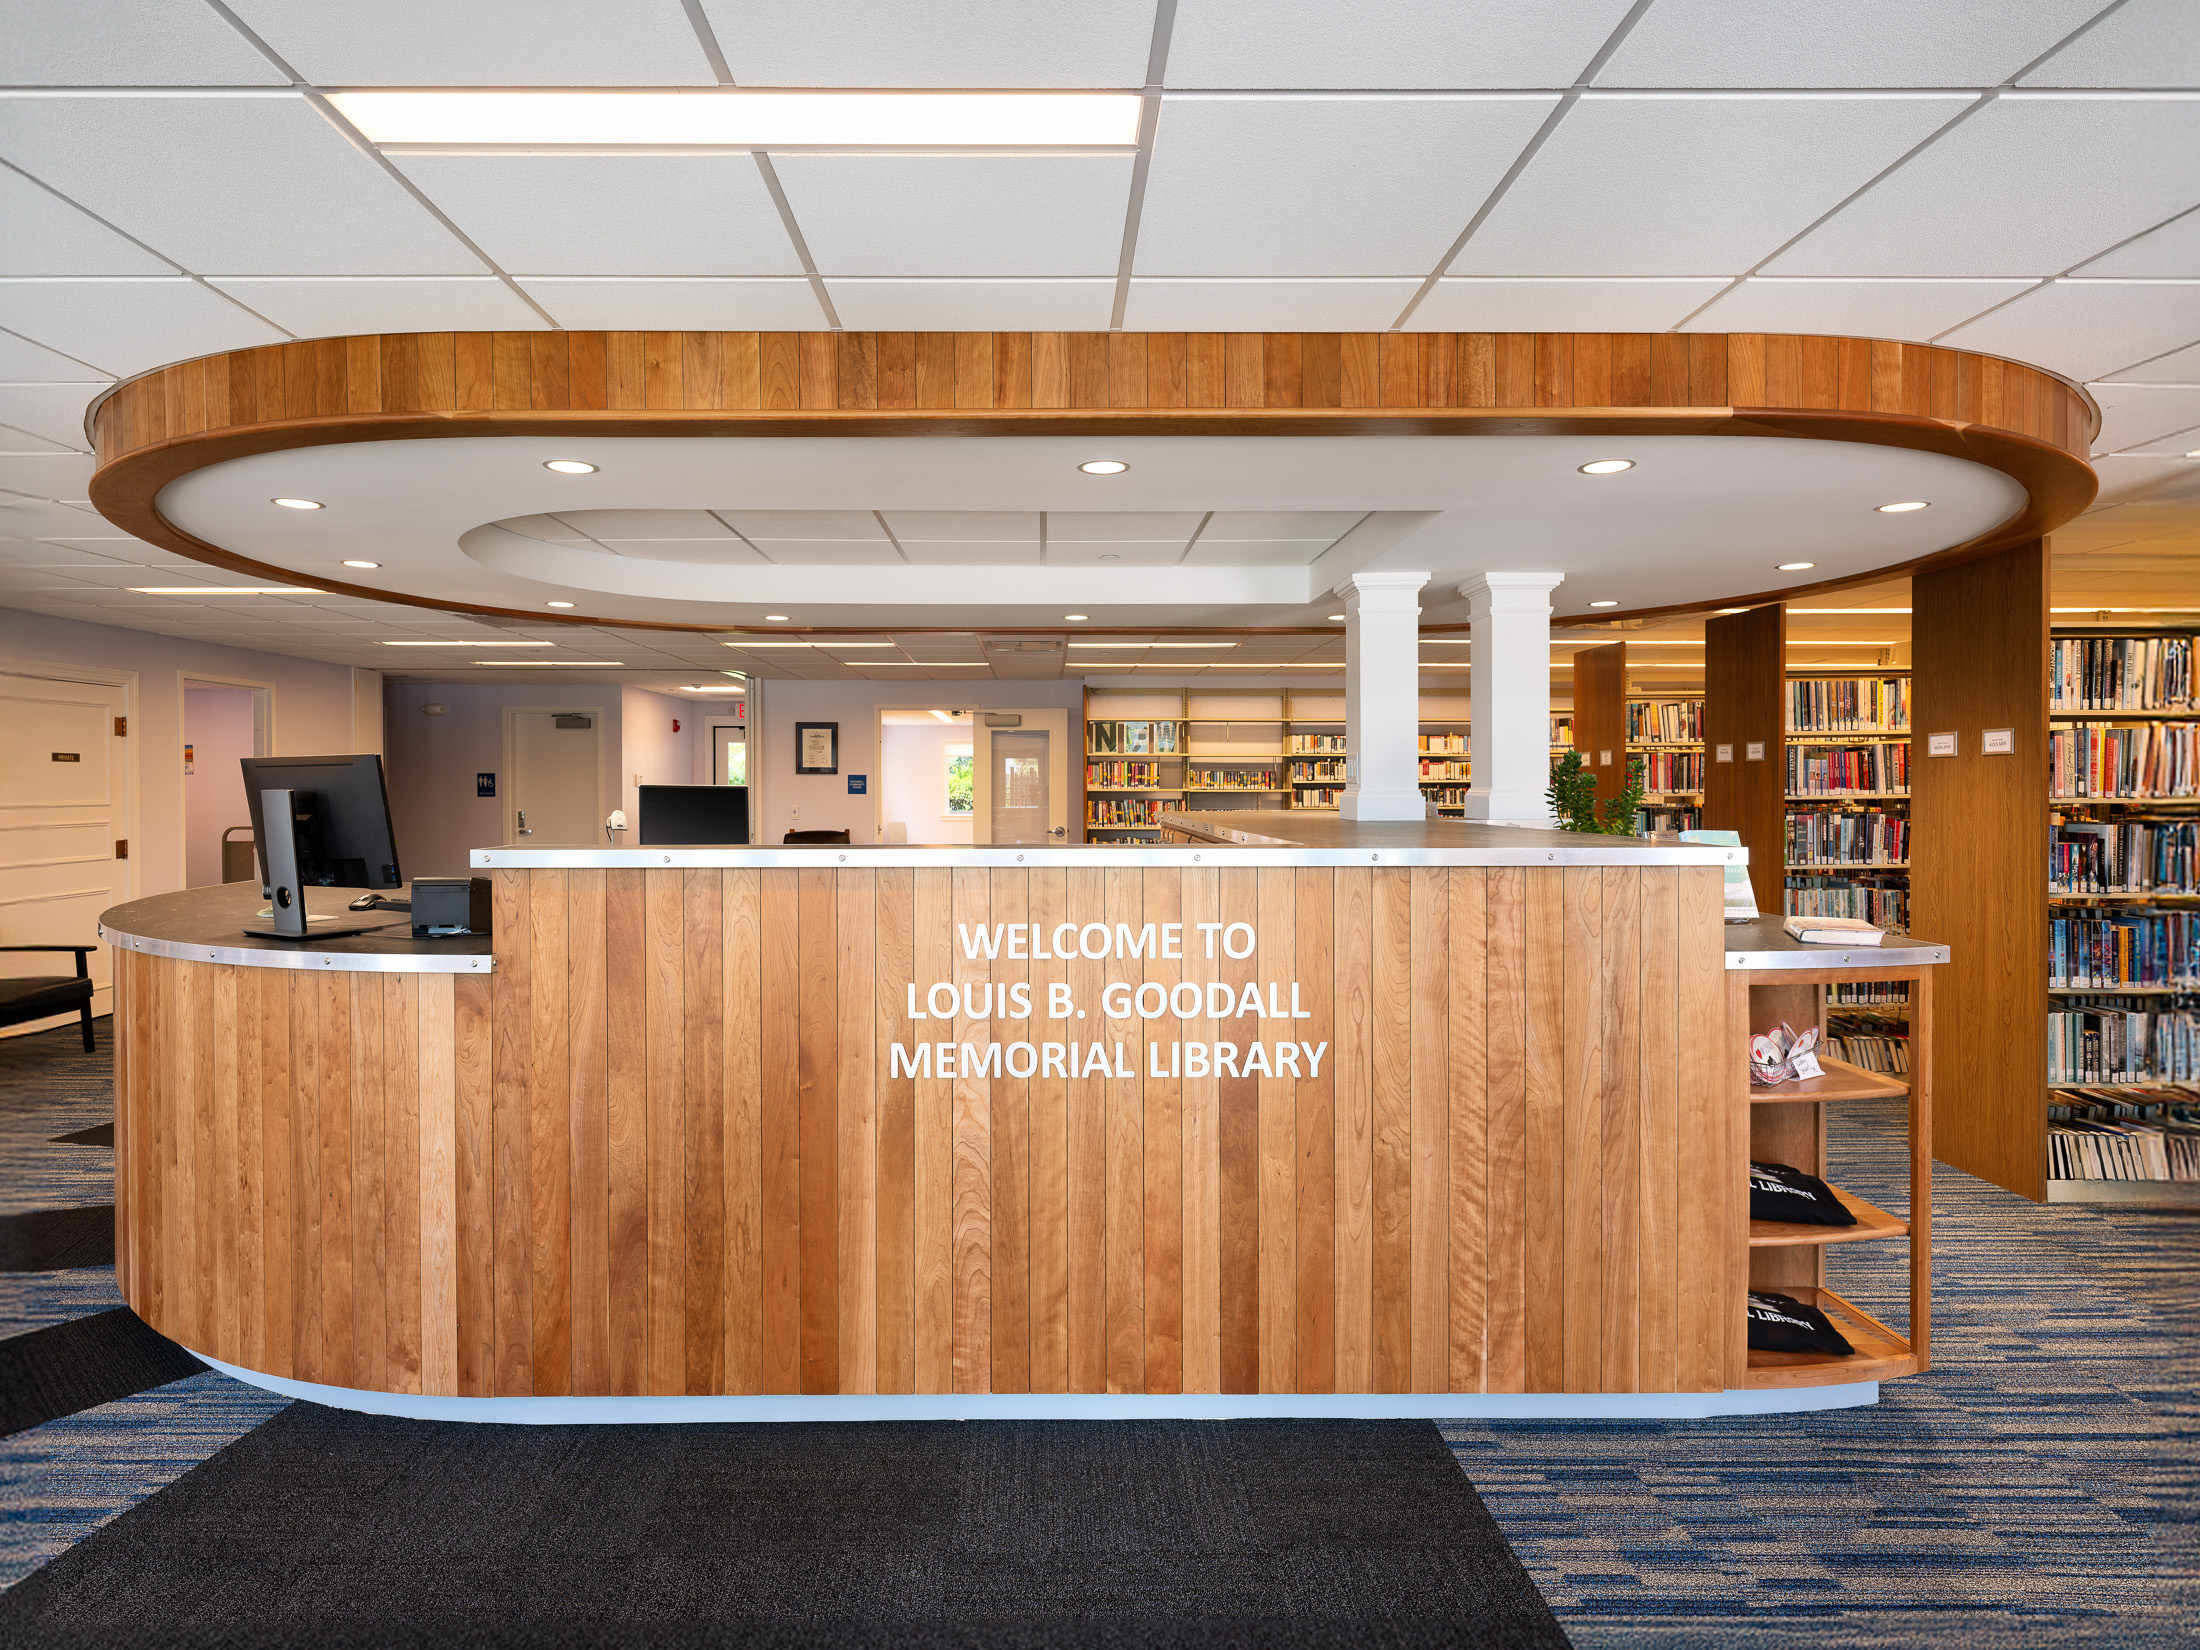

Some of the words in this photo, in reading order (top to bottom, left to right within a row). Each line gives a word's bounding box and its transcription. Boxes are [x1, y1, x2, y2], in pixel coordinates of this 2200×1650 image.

[958, 923, 1183, 960] WELCOME
[1196, 922, 1256, 960] TO
[907, 982, 1033, 1019] LOUIS
[1048, 982, 1086, 1019] B.
[1101, 982, 1311, 1019] GOODALL
[890, 1041, 1135, 1078] MEMORIAL
[1150, 1041, 1328, 1078] LIBRARY
